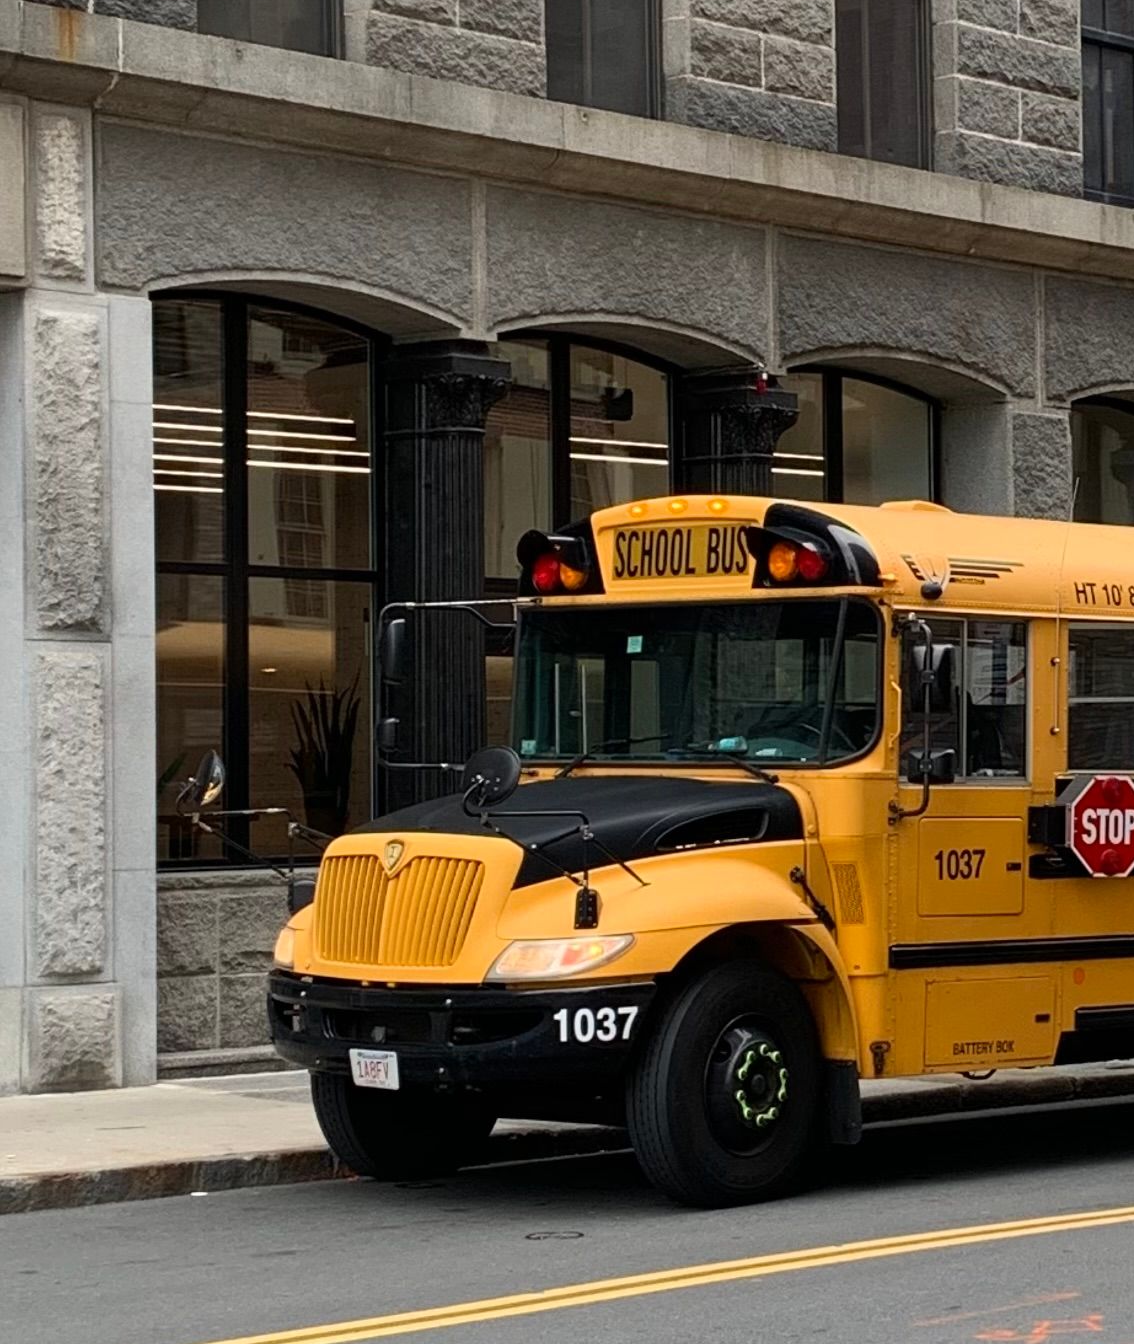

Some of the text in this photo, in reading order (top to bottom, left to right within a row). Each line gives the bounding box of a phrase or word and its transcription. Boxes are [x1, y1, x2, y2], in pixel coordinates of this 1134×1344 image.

[614, 525, 748, 578] SCHOOL BUS
[1073, 581, 1097, 605] HT
[1102, 583, 1123, 606] 10'
[934, 848, 986, 881] 1037
[552, 1005, 639, 1044] 1037
[952, 1040, 1015, 1055] BATTERY BOX
